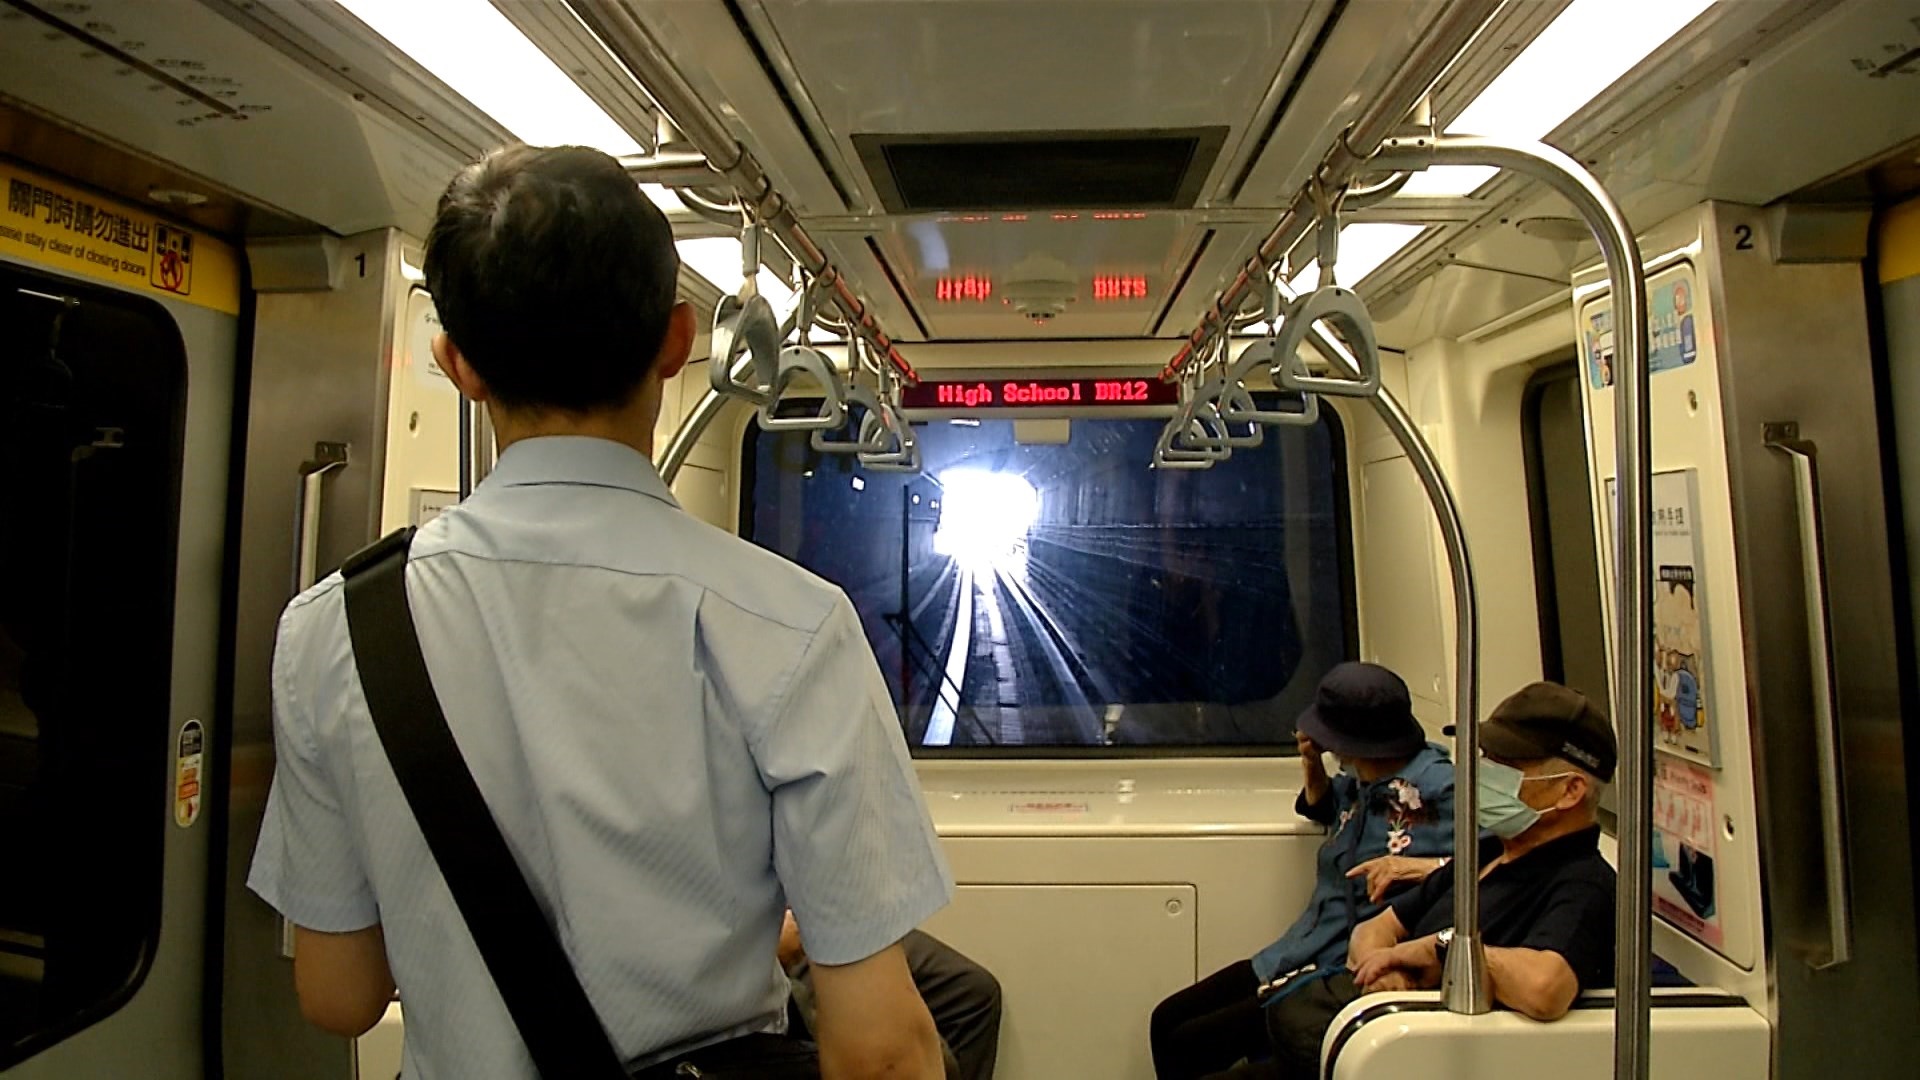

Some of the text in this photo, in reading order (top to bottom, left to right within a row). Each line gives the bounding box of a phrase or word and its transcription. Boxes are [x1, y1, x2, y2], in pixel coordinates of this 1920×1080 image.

[9, 178, 149, 252] 關門時請勿進出
[1734, 224, 1754, 251] 2
[25, 231, 46, 252] stay
[48, 238, 73, 257] clear
[86, 249, 119, 272] closing
[121, 258, 146, 277] doors
[354, 252, 366, 278] 1
[938, 381, 1149, 406] High School BR12
